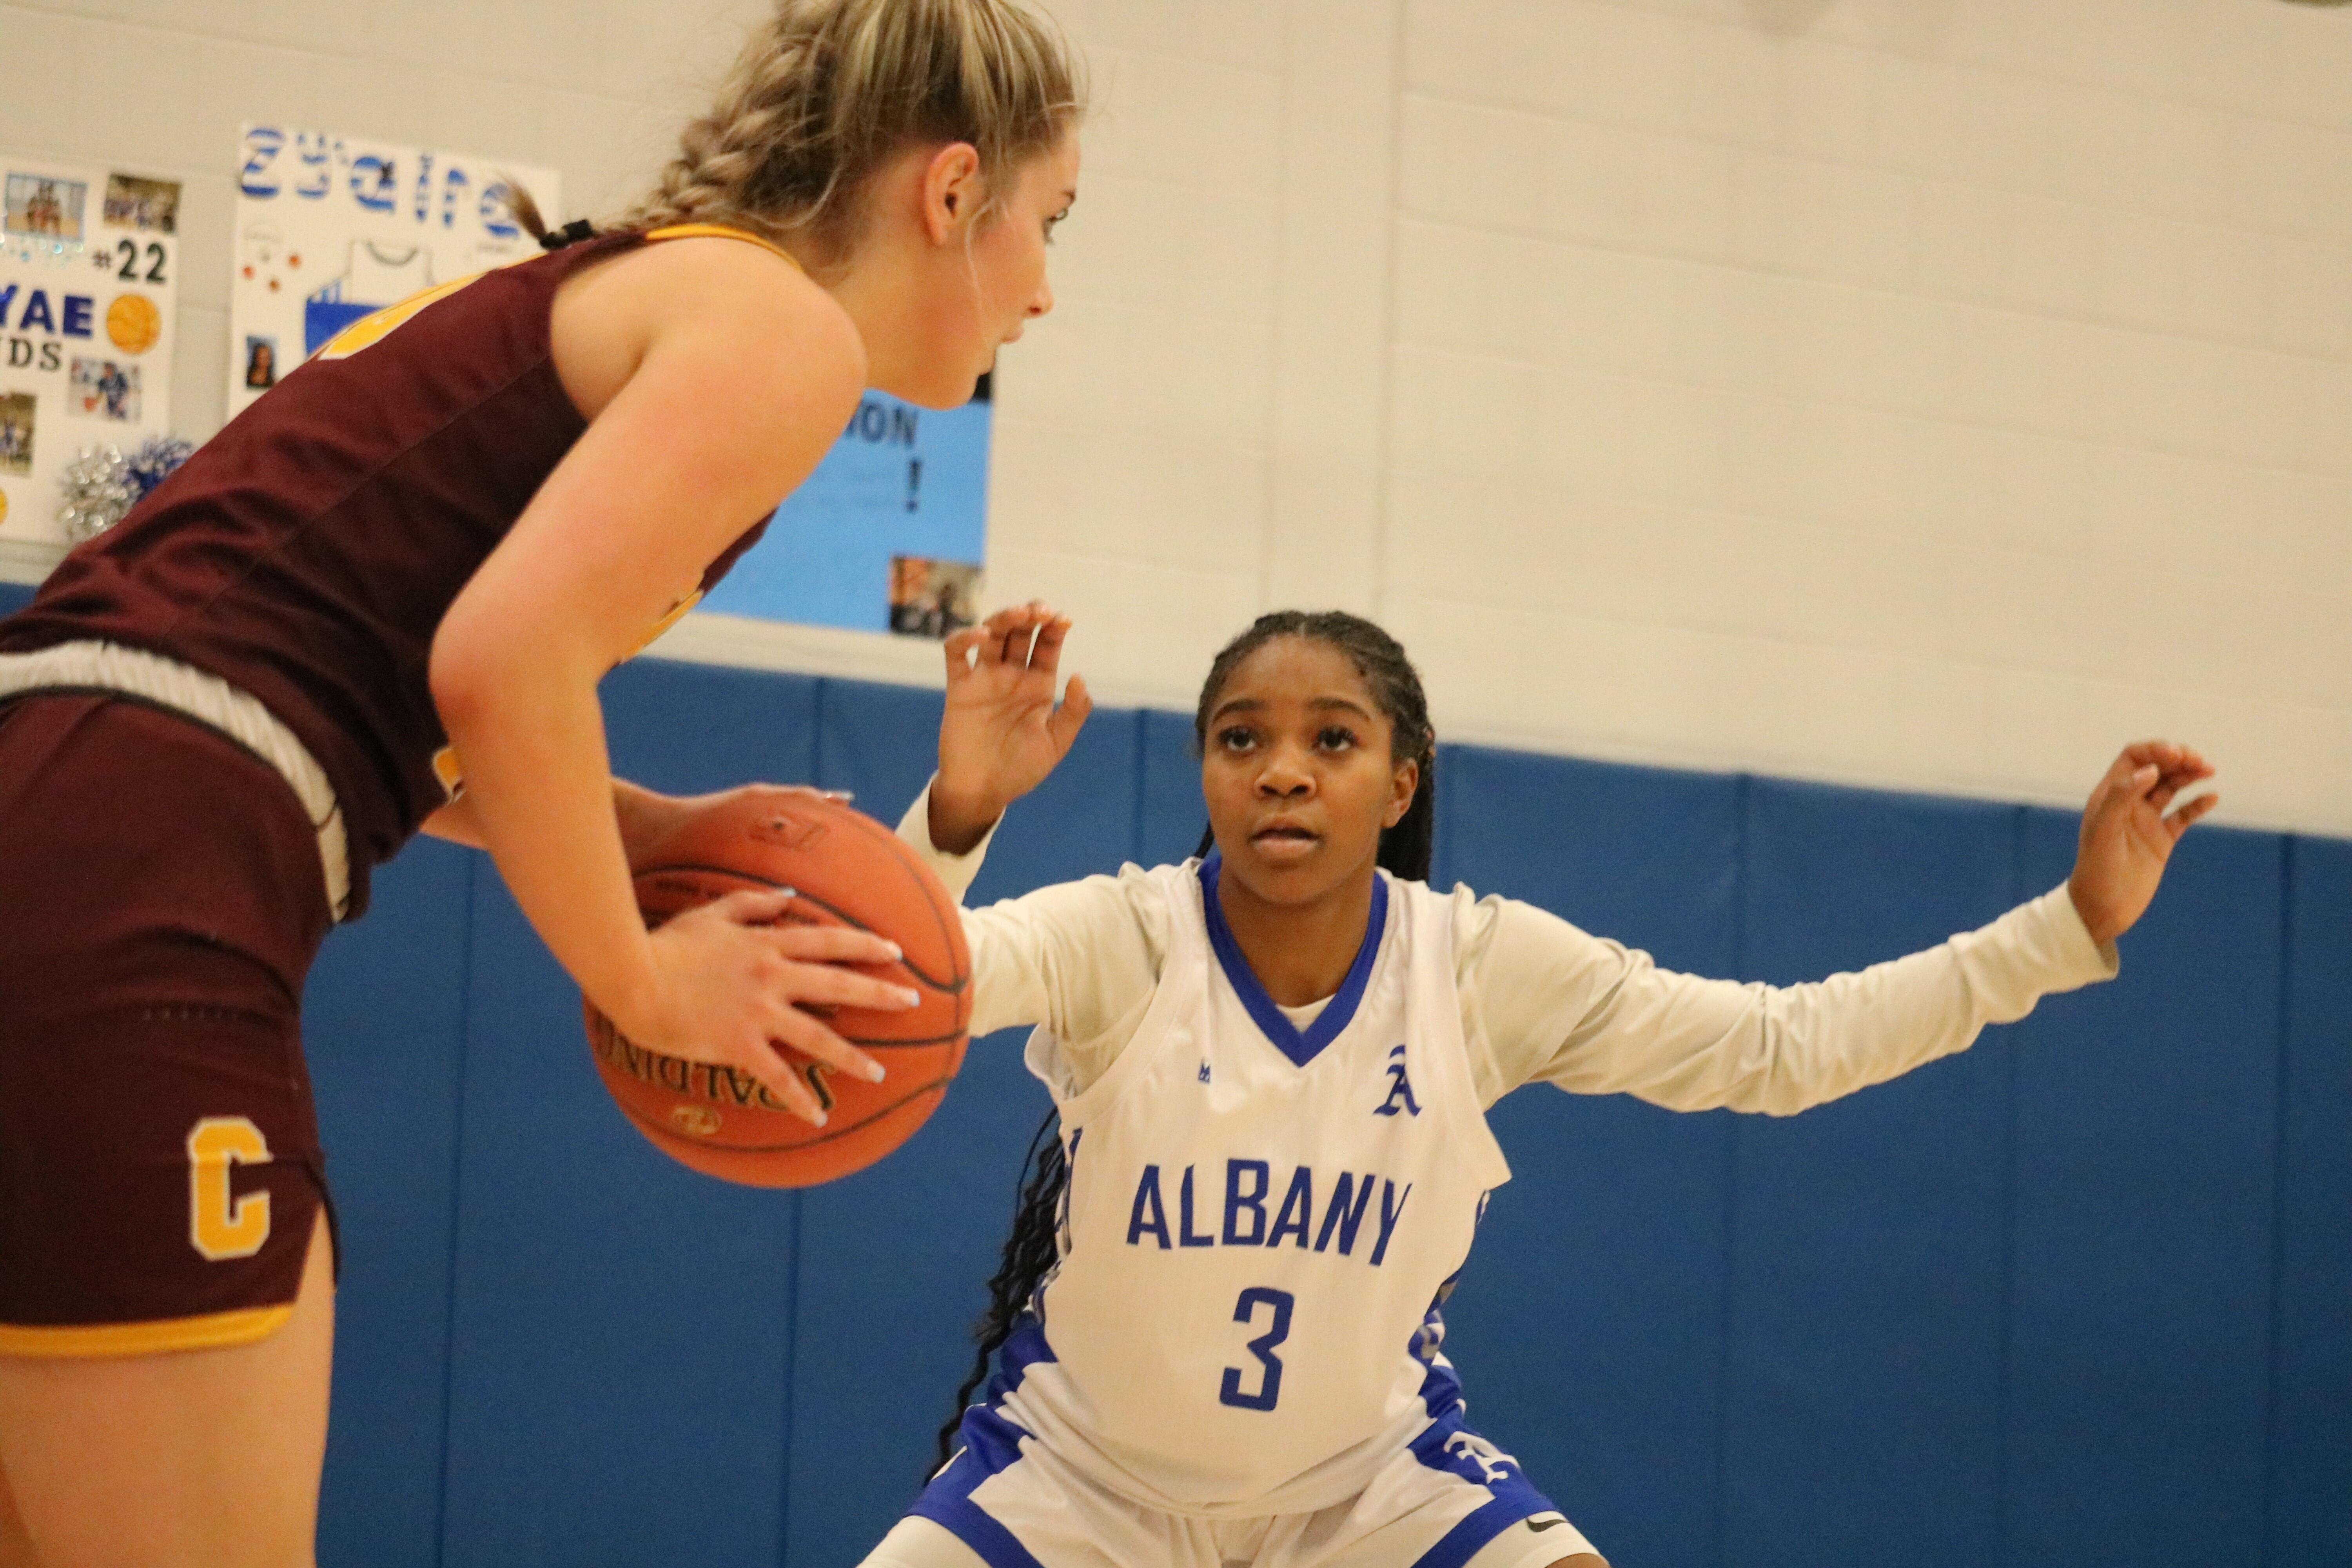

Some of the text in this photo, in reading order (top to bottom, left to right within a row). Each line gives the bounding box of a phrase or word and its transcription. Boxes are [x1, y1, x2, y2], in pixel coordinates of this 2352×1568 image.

[1373, 1044, 1422, 1117] A
[187, 1116, 273, 1261] C
[1126, 1158, 1412, 1266] ALBANY
[1220, 1287, 1295, 1411] 3
